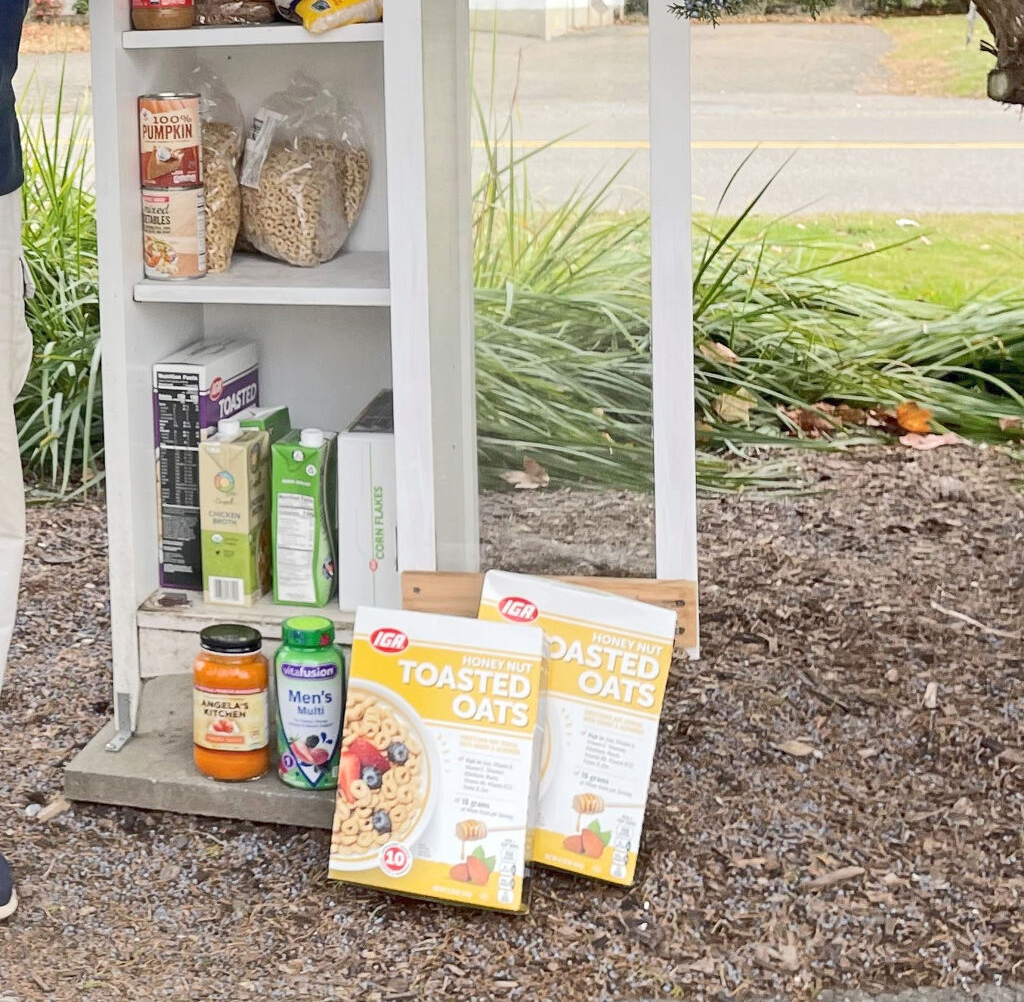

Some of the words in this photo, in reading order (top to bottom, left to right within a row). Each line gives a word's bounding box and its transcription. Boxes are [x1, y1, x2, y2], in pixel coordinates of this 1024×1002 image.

[153, 115, 192, 124] 100%
[142, 124, 192, 140] PUMPKIN
[219, 382, 257, 418] TOASTED
[208, 510, 241, 519] CHICKEN
[373, 486, 384, 525] FLAKES
[212, 518, 238, 526] BROTH
[375, 528, 385, 559] CORN
[501, 600, 533, 619] IGA
[373, 631, 405, 649] IGA
[592, 632, 635, 649] HONEY
[636, 642, 663, 655] NUT
[462, 655, 505, 671] HONEY
[506, 660, 533, 674] NUT
[550, 635, 660, 680] OASTED
[282, 665, 334, 678] vitafusion
[398, 659, 531, 700] TOASTED
[288, 689, 333, 704] Men's
[578, 670, 656, 708] OATS
[202, 700, 249, 710] ANGELA'S
[204, 709, 247, 718] KITCHEN
[297, 706, 325, 715] Multi
[451, 694, 529, 728] OATS
[384, 850, 403, 867] 10
